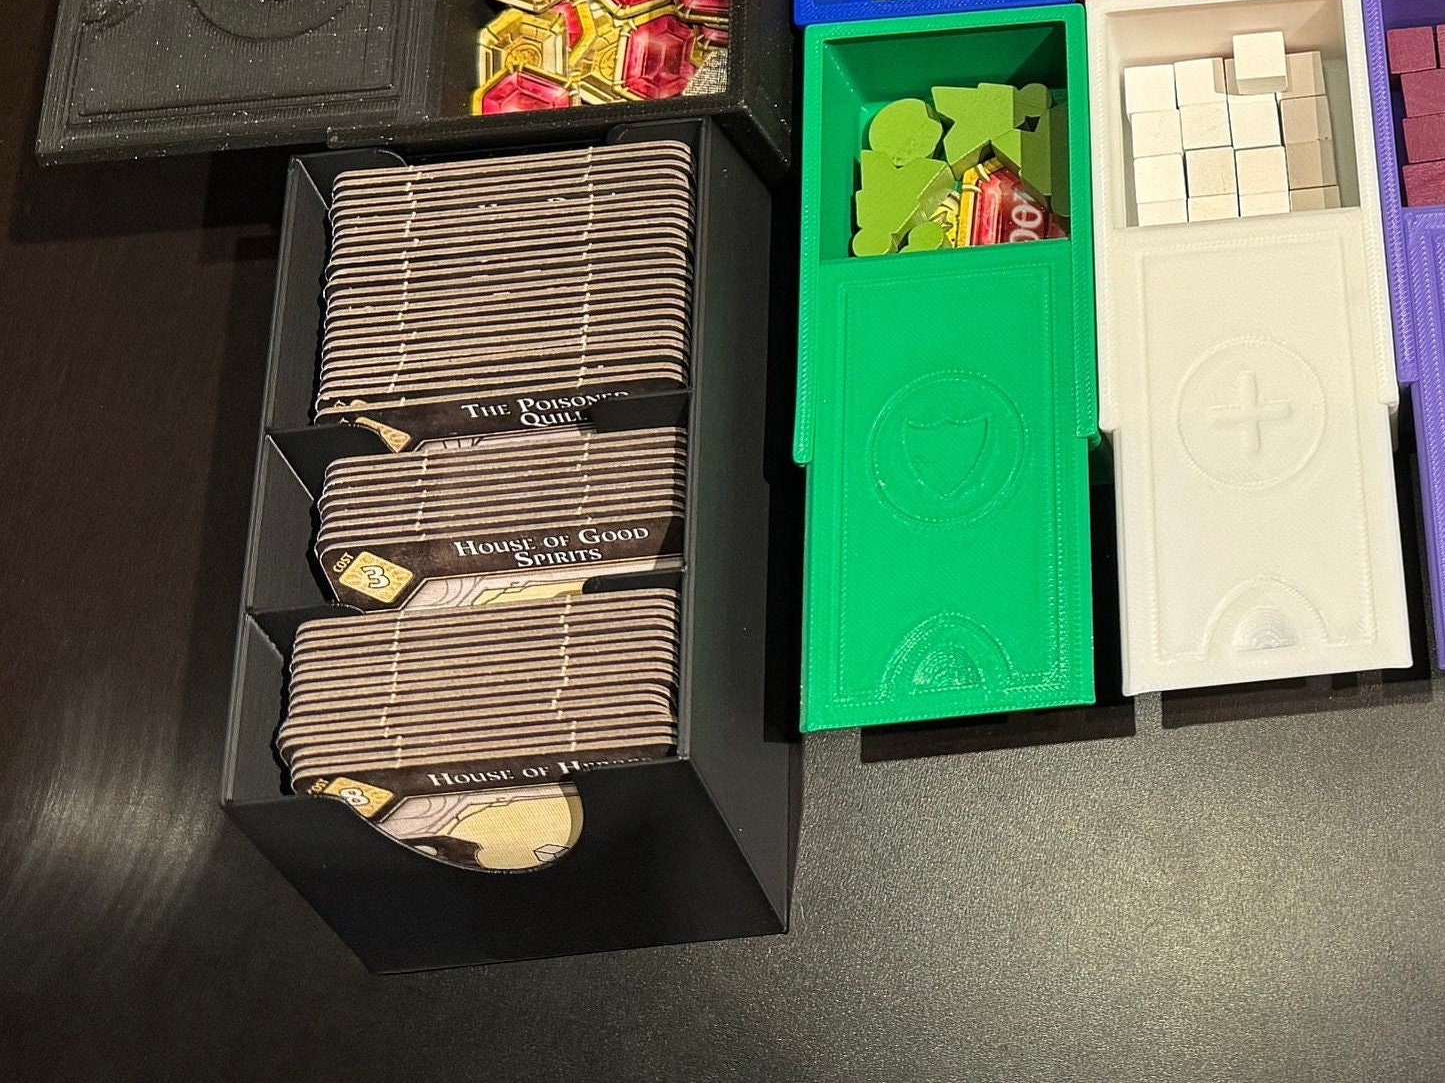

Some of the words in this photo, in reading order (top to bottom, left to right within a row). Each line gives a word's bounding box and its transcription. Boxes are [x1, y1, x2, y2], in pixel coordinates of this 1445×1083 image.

[462, 402, 512, 419] THE
[453, 538, 537, 557] HOUSE
[543, 534, 571, 548] OF
[578, 527, 649, 545] GOOD
[333, 552, 354, 573] COST
[514, 548, 602, 567] SPIRITS
[361, 565, 390, 589] 3
[427, 769, 514, 787] HOUSE
[522, 766, 549, 778] OF
[339, 787, 370, 806] 8
